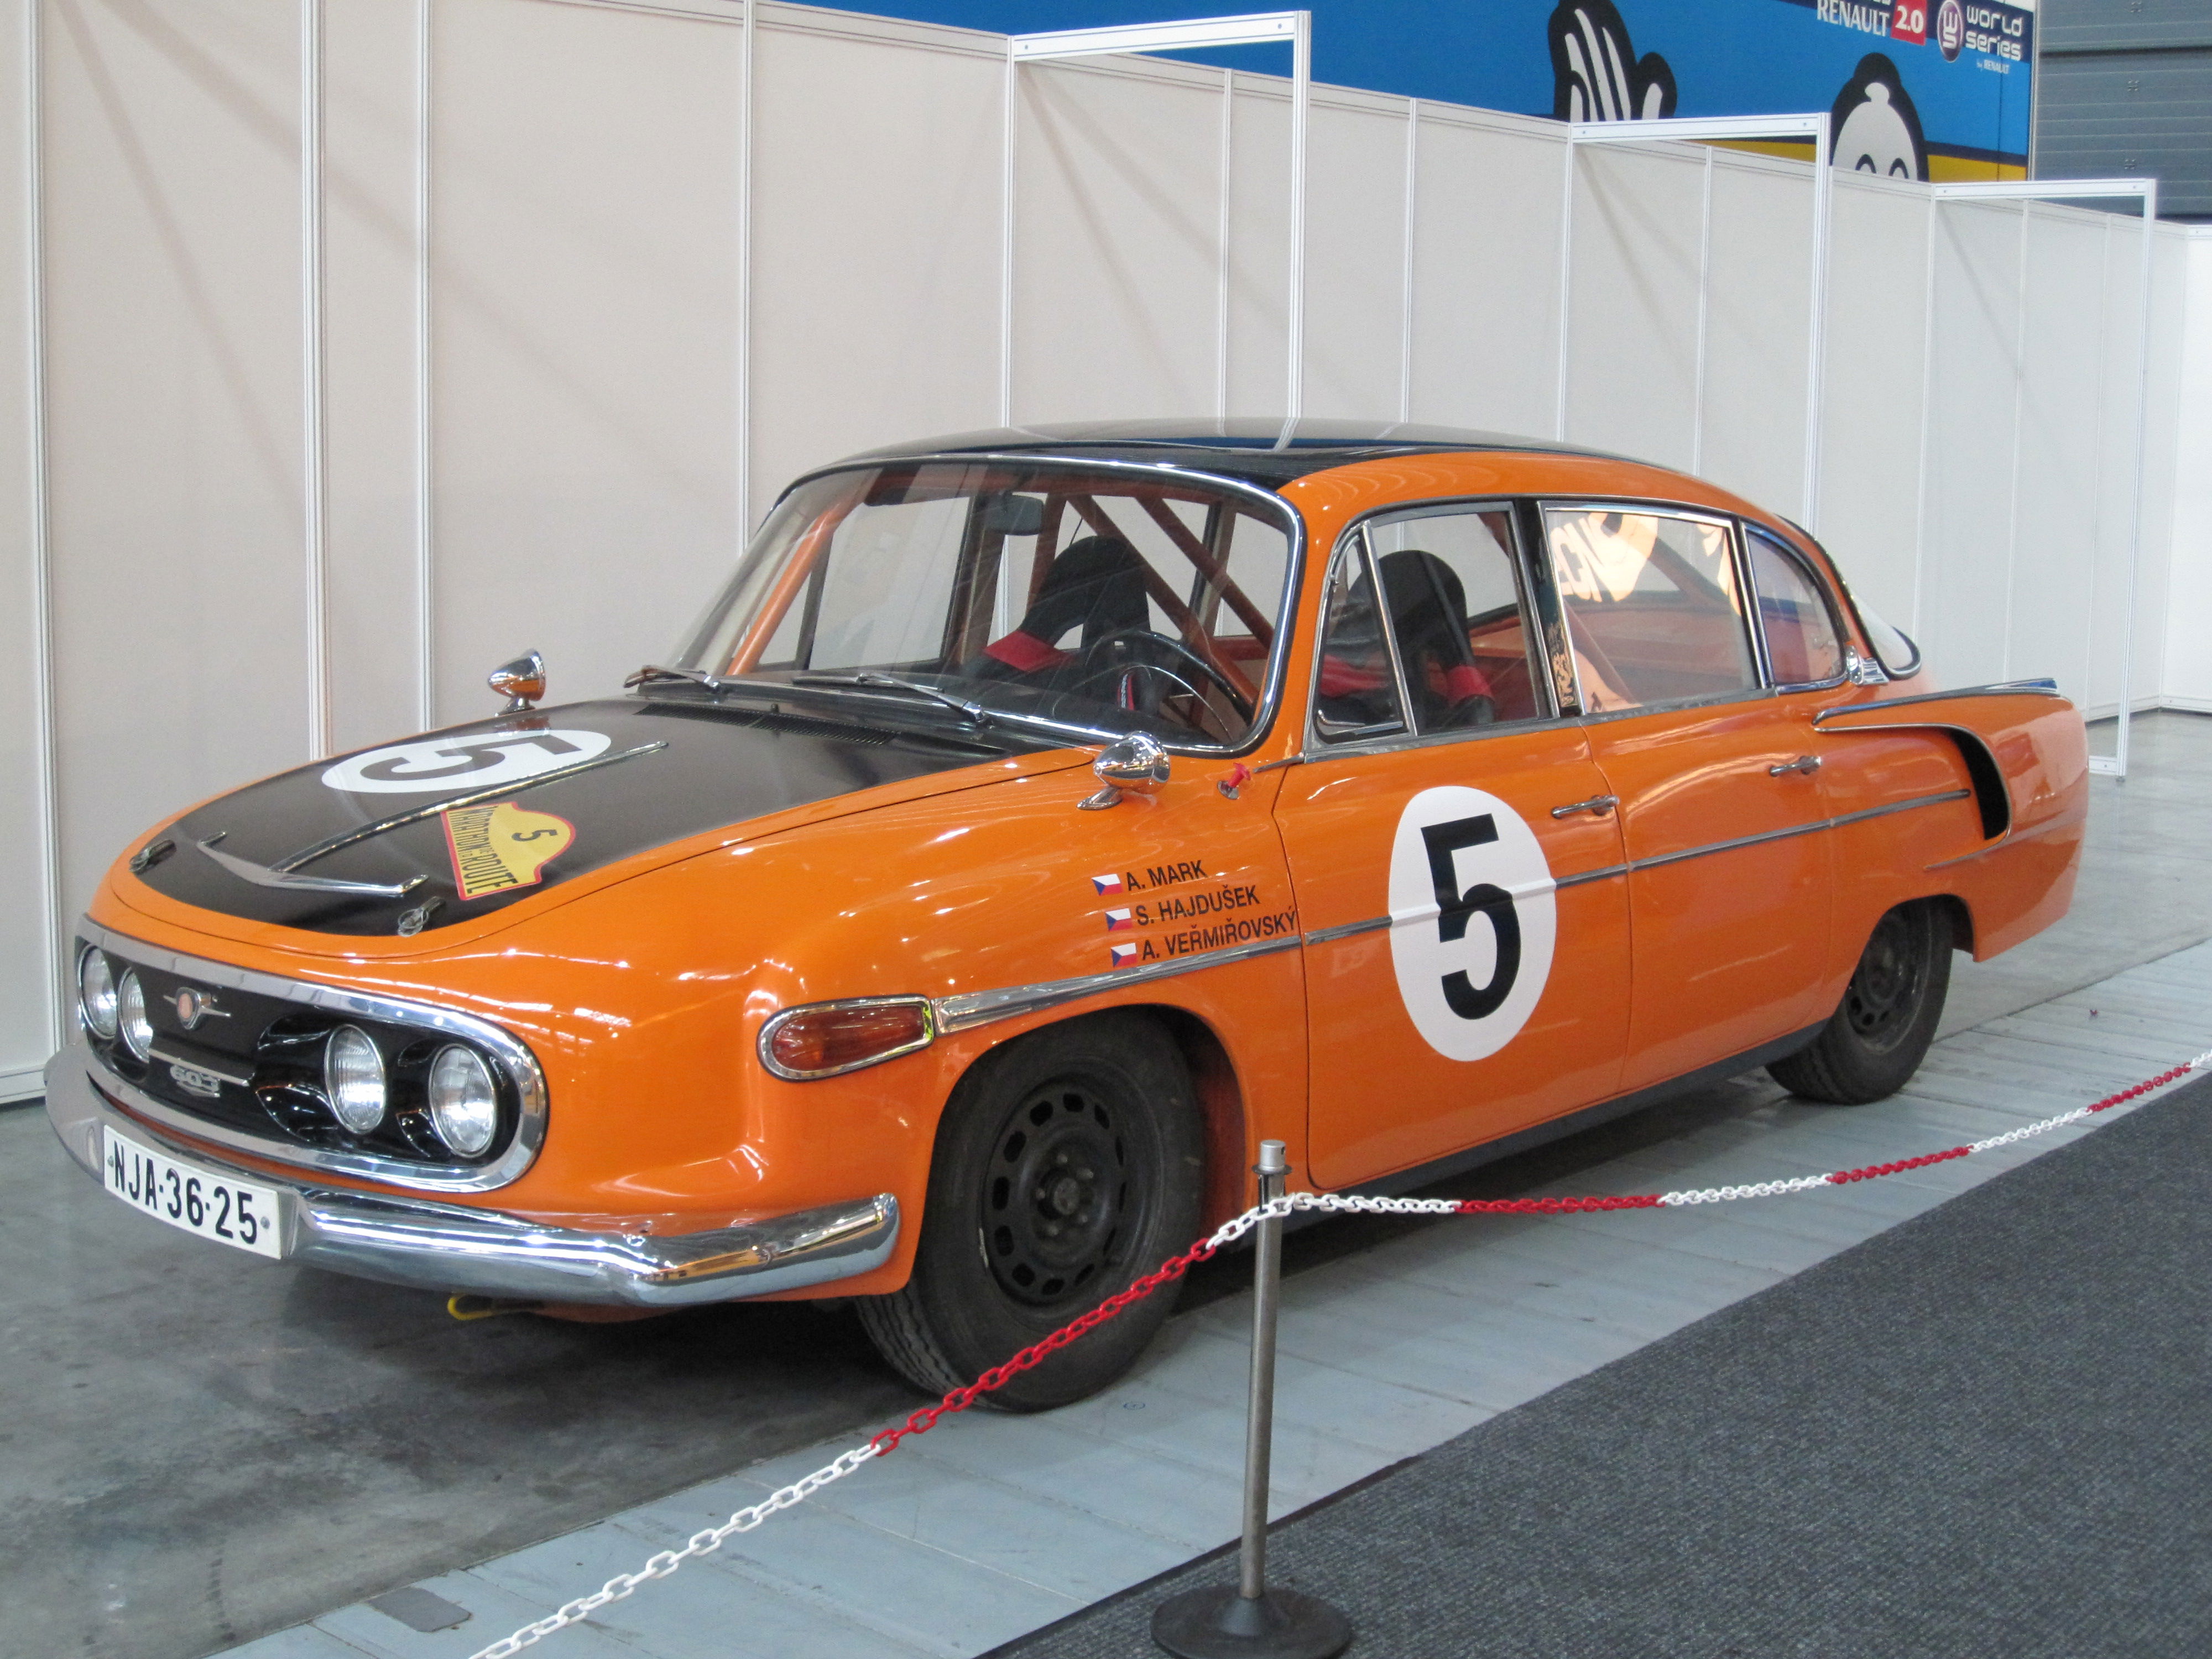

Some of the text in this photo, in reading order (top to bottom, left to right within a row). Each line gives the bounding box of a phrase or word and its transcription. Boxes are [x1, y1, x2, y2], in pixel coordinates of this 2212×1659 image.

[1817, 0, 1924, 37] RENAULT 2.0
[1965, 30, 2022, 61] series
[359, 734, 582, 781] 5
[511, 829, 557, 841] 5
[460, 853, 518, 893] ROUTE
[1127, 860, 1208, 891] A. MARK
[1135, 885, 1261, 926] S. HAJDUŠEK
[1421, 813, 1521, 1020] 5
[1142, 906, 1298, 961] A. VEŘMIŘOVSKÝ
